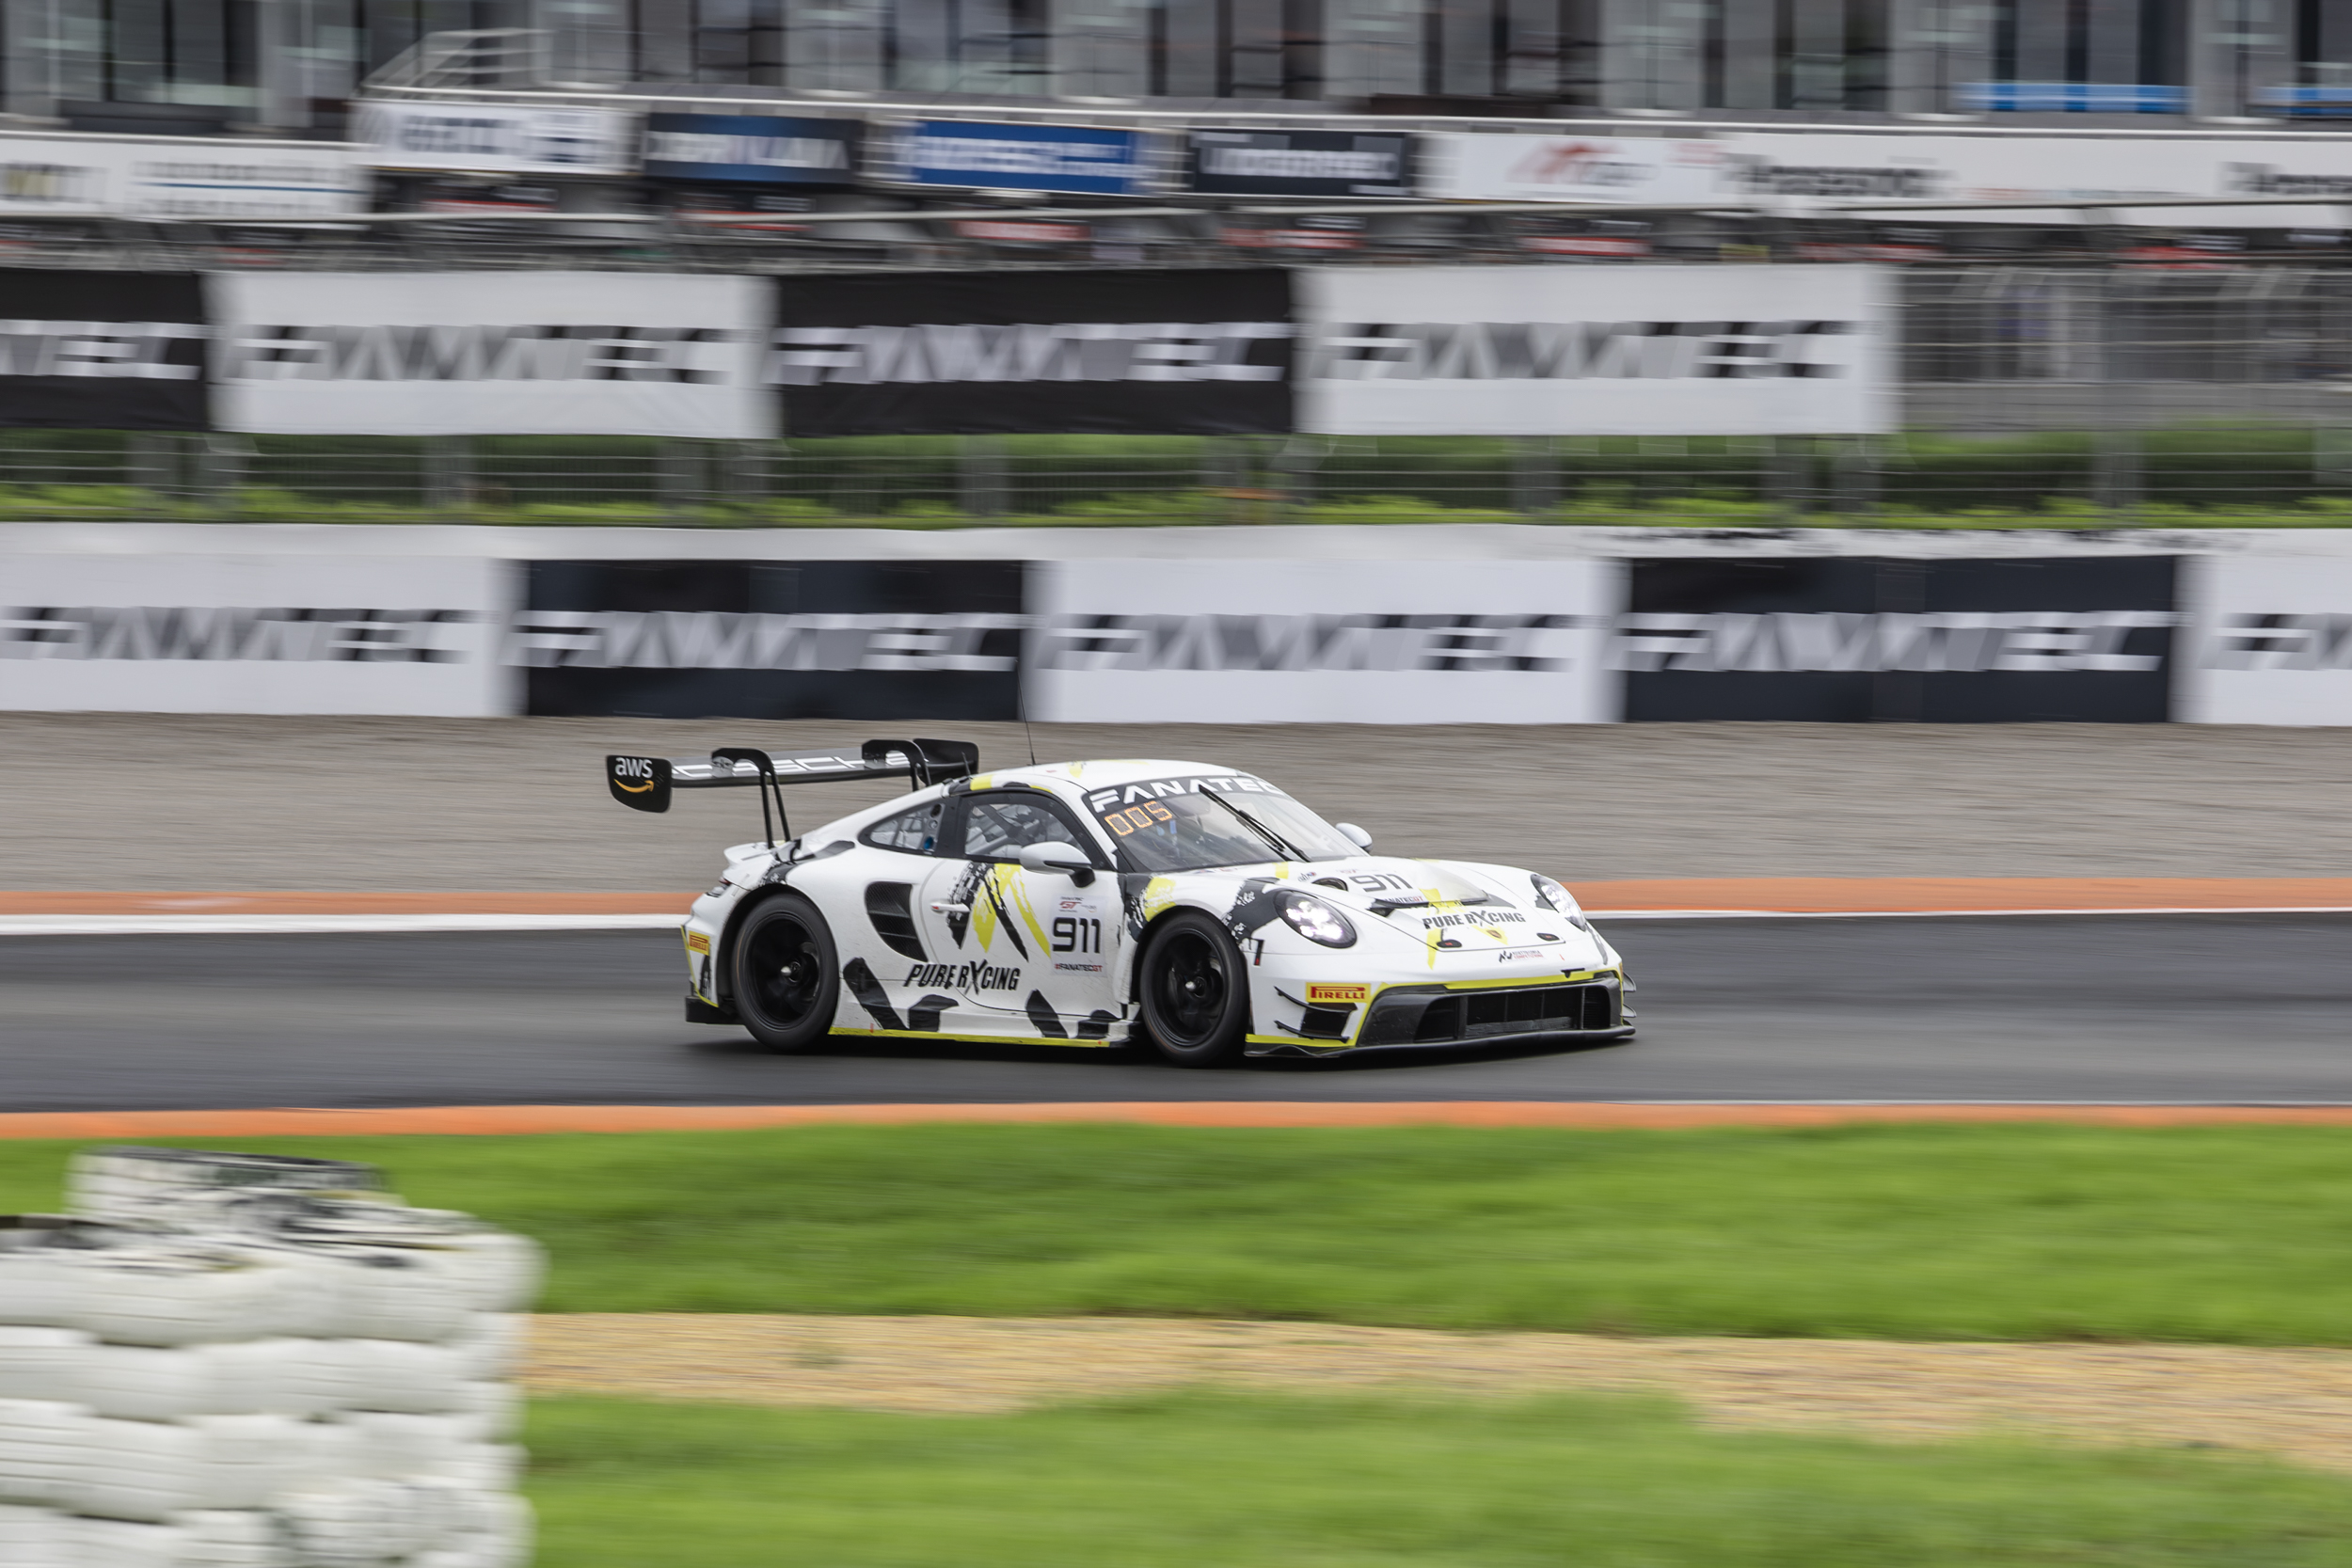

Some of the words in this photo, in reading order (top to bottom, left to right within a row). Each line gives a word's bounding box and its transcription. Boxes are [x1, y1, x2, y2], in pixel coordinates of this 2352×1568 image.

[614, 756, 654, 779] aws
[1089, 778, 1286, 814] FANATEC
[1348, 873, 1414, 894] 911
[1422, 913, 1465, 930] PURE
[1051, 916, 1102, 955] 911
[902, 963, 958, 990] PURE
[1310, 985, 1366, 1000] PIRELLI
